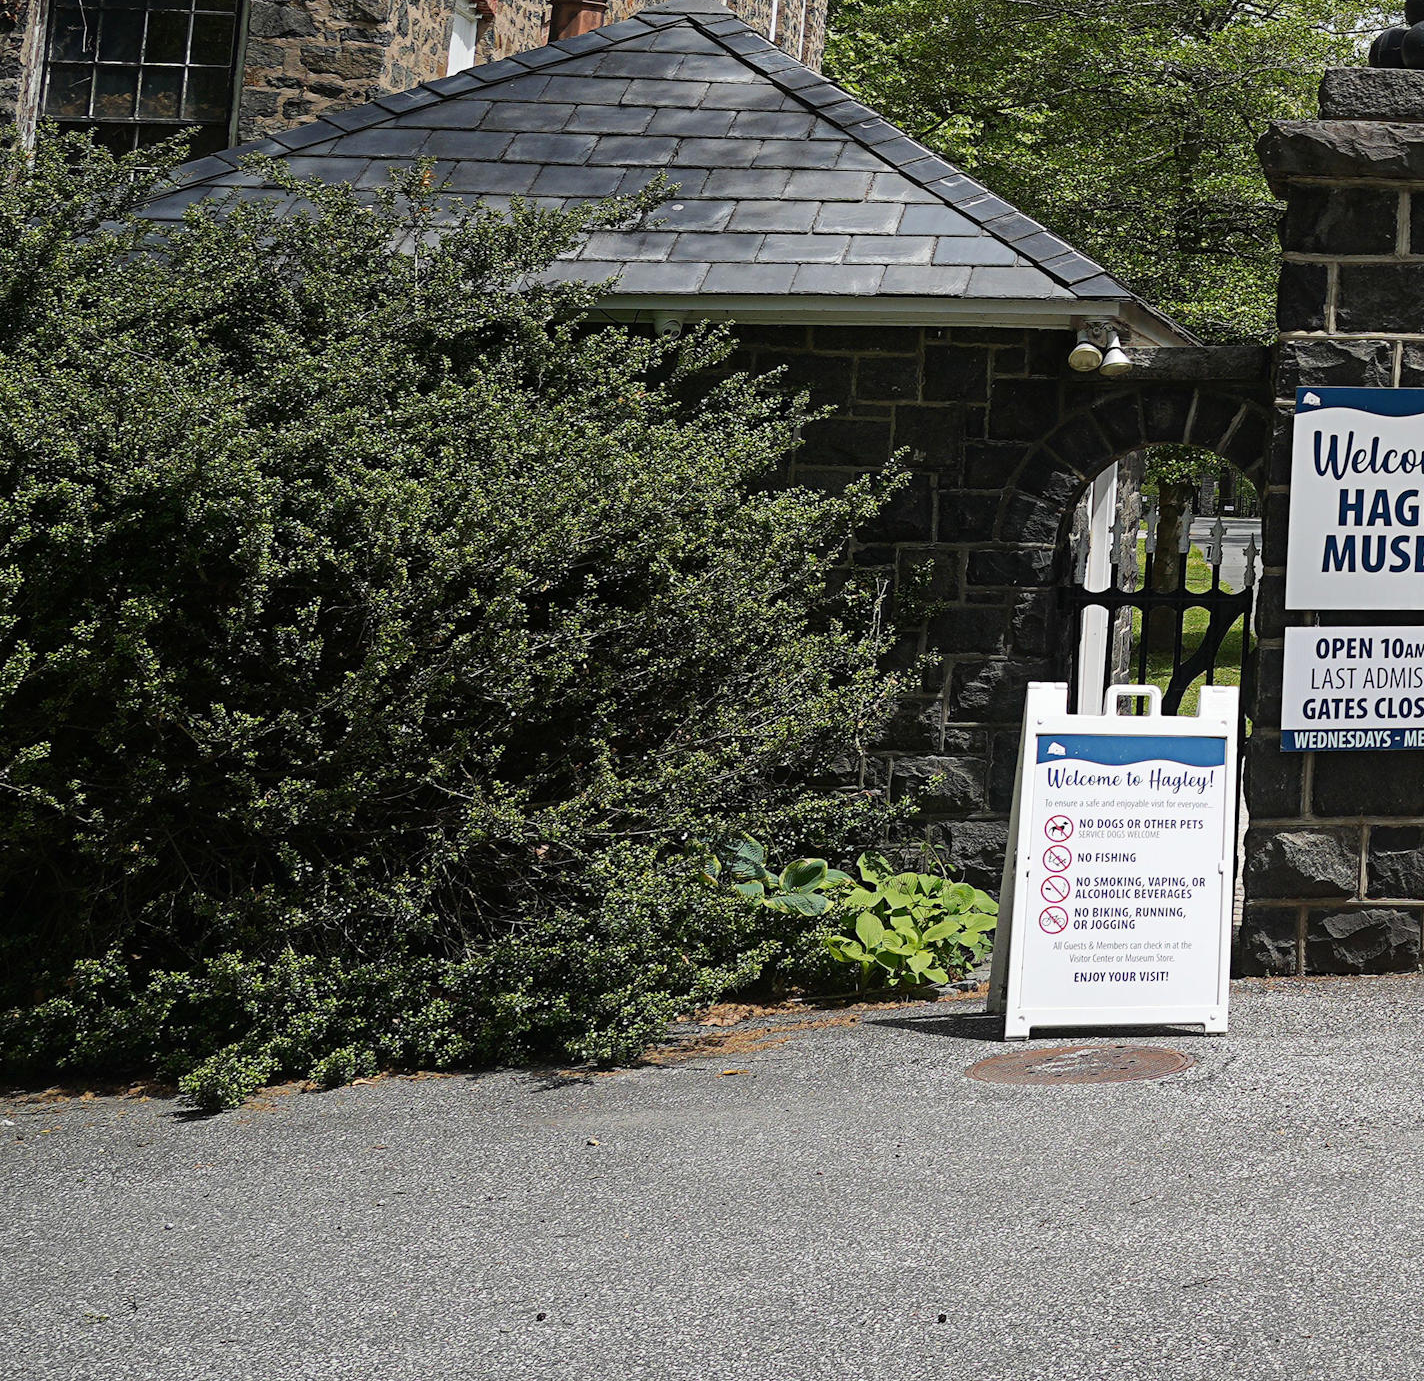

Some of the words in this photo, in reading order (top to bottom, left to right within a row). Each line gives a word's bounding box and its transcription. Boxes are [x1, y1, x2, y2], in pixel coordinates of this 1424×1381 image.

[1316, 638, 1372, 659] OPEN
[1311, 668, 1357, 690] LAST
[1303, 698, 1368, 720] GATES
[1294, 730, 1391, 748] WEDNESDAYS
[1048, 768, 1122, 788] Welcome
[1127, 772, 1143, 786] to
[1149, 768, 1214, 794] Hagley!
[1045, 799, 1052, 807] To
[1086, 799, 1099, 807] safe
[1116, 800, 1149, 809] enjoyable
[1166, 800, 1175, 808] for
[1079, 819, 1094, 828] NO
[1097, 819, 1124, 829] DOGS
[1127, 819, 1141, 829] OR
[1144, 819, 1177, 829] OTHER
[1180, 820, 1203, 829] PETS
[1078, 830, 1104, 838] SERVICE
[1107, 830, 1125, 838] DOGS
[1127, 830, 1160, 838] WELCOME
[1078, 853, 1092, 862] NO
[1096, 853, 1136, 862] FISHING
[1076, 877, 1090, 886] NO
[1094, 877, 1145, 888] SMOKING,
[1148, 877, 1189, 888] VAPING,
[1192, 877, 1206, 887] OR
[1075, 889, 1131, 899] ALCOHOLIC
[1134, 889, 1192, 899] BEVERAGES
[1074, 908, 1089, 917] NO
[1093, 908, 1132, 919] BIKING,
[1136, 908, 1186, 919] RUNNING,
[1074, 920, 1088, 929] OR
[1091, 920, 1136, 930] JOGGING
[1053, 941, 1062, 950] All
[1064, 942, 1087, 950] Guests
[1089, 942, 1094, 950] &
[1096, 941, 1128, 950] Members
[1144, 941, 1162, 949] check
[1164, 941, 1170, 949] in
[1181, 941, 1192, 949] the
[1069, 954, 1091, 963] Visitor
[1093, 954, 1114, 963] Center
[1125, 954, 1154, 962] Museum
[1156, 954, 1175, 962] Store.
[1074, 972, 1106, 982] ENJOY
[1109, 972, 1136, 982] YOUR
[1139, 972, 1168, 982] VISIT!
